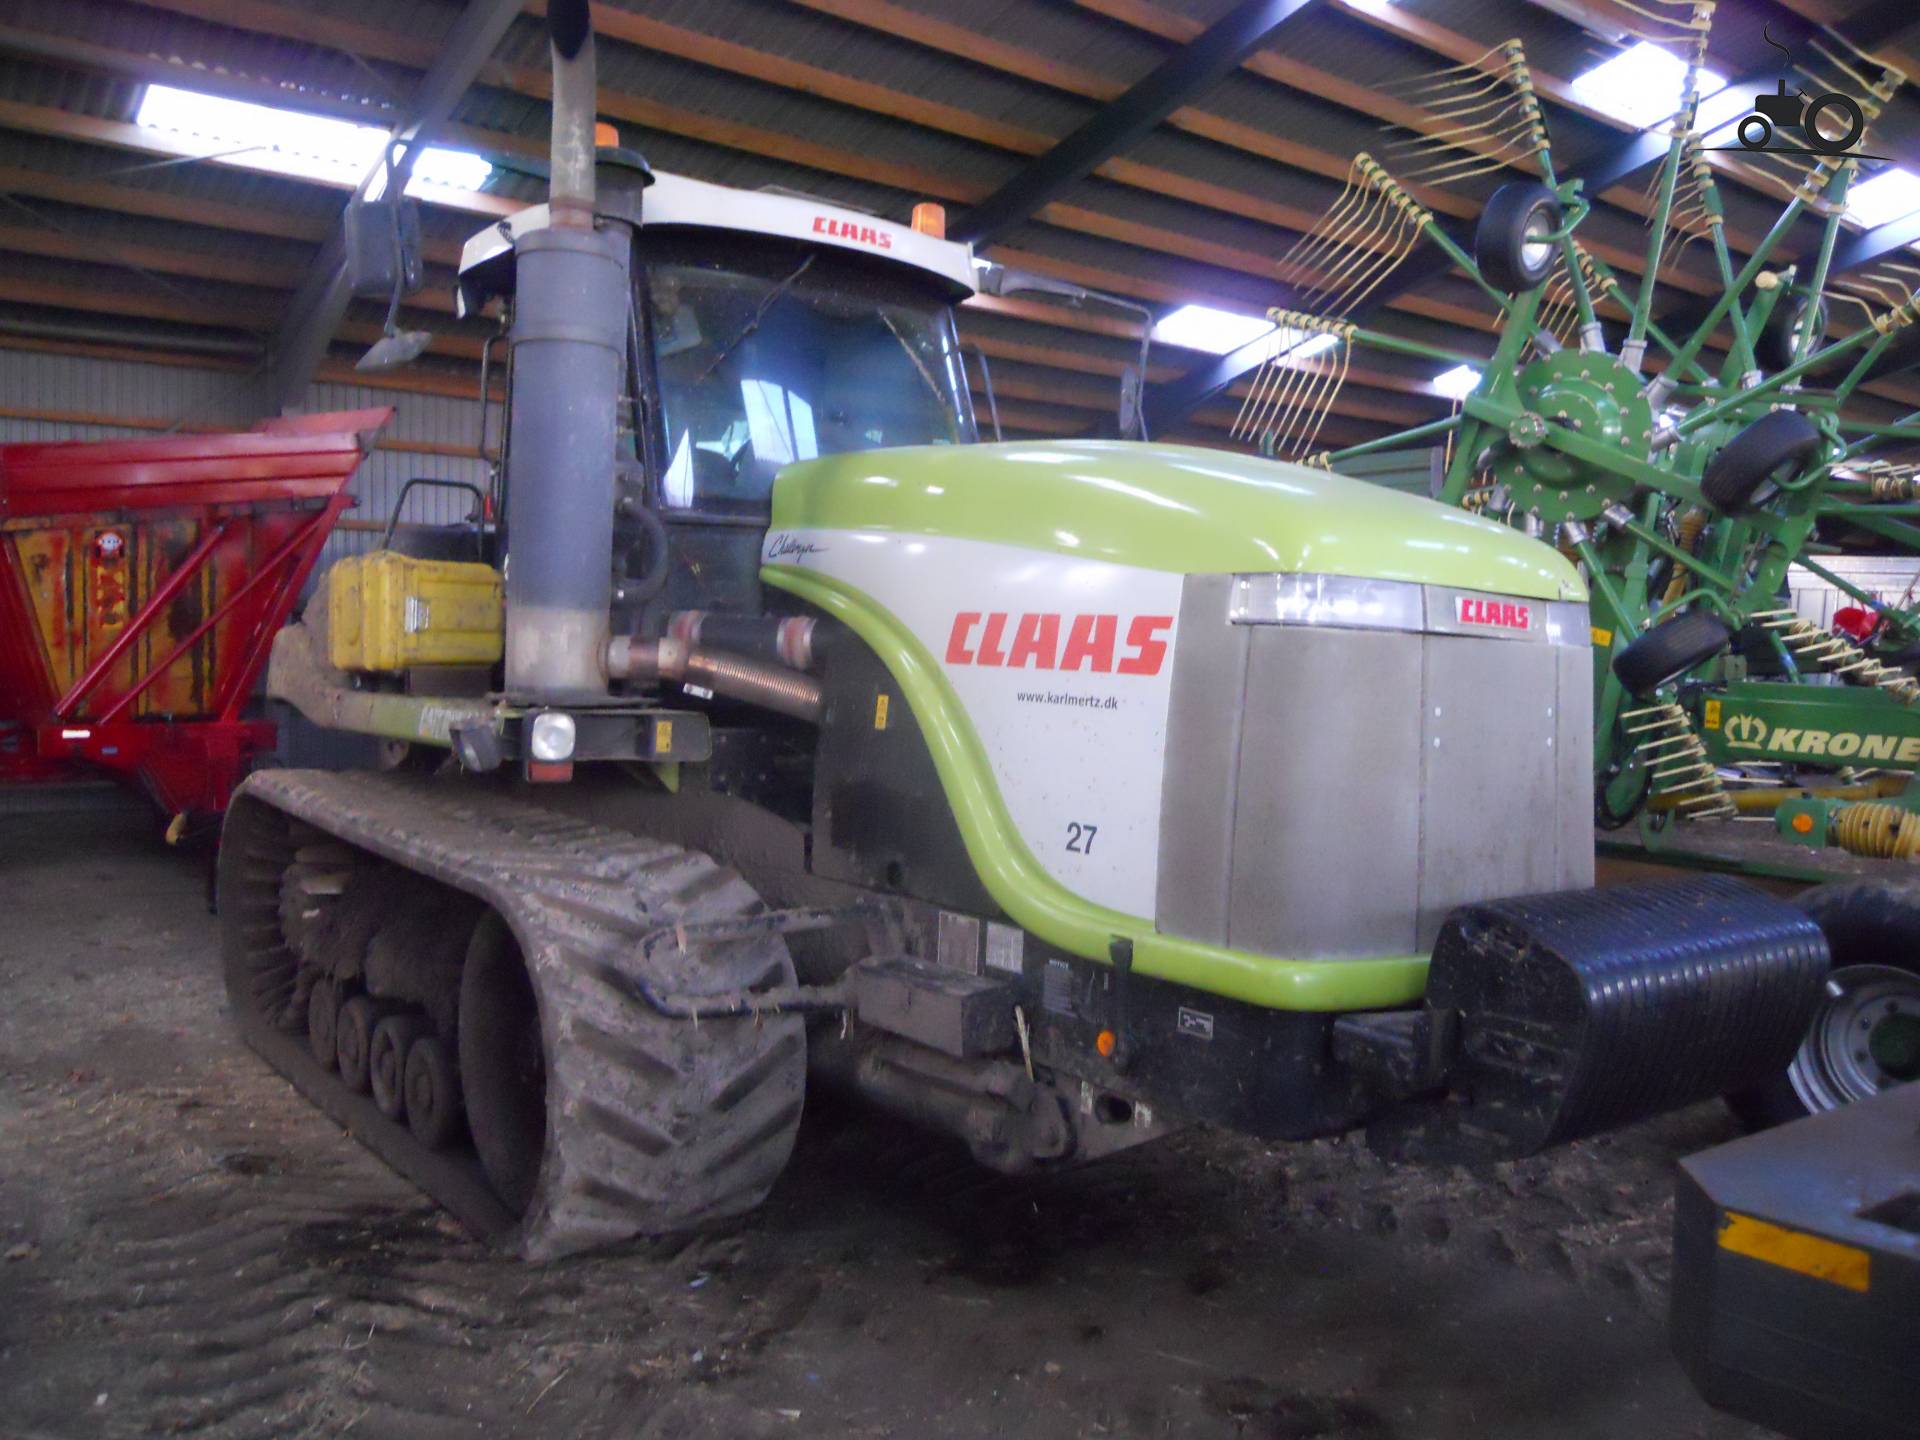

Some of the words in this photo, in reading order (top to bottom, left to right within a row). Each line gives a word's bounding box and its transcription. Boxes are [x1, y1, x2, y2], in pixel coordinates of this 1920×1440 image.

[812, 216, 892, 249] CLAAS
[1461, 598, 1529, 631] CLAAS
[945, 612, 1174, 676] CLAAS
[1017, 691, 1119, 710] www.karlmertz.dk
[1767, 727, 1920, 762] KRONE
[1065, 822, 1098, 855] 27
